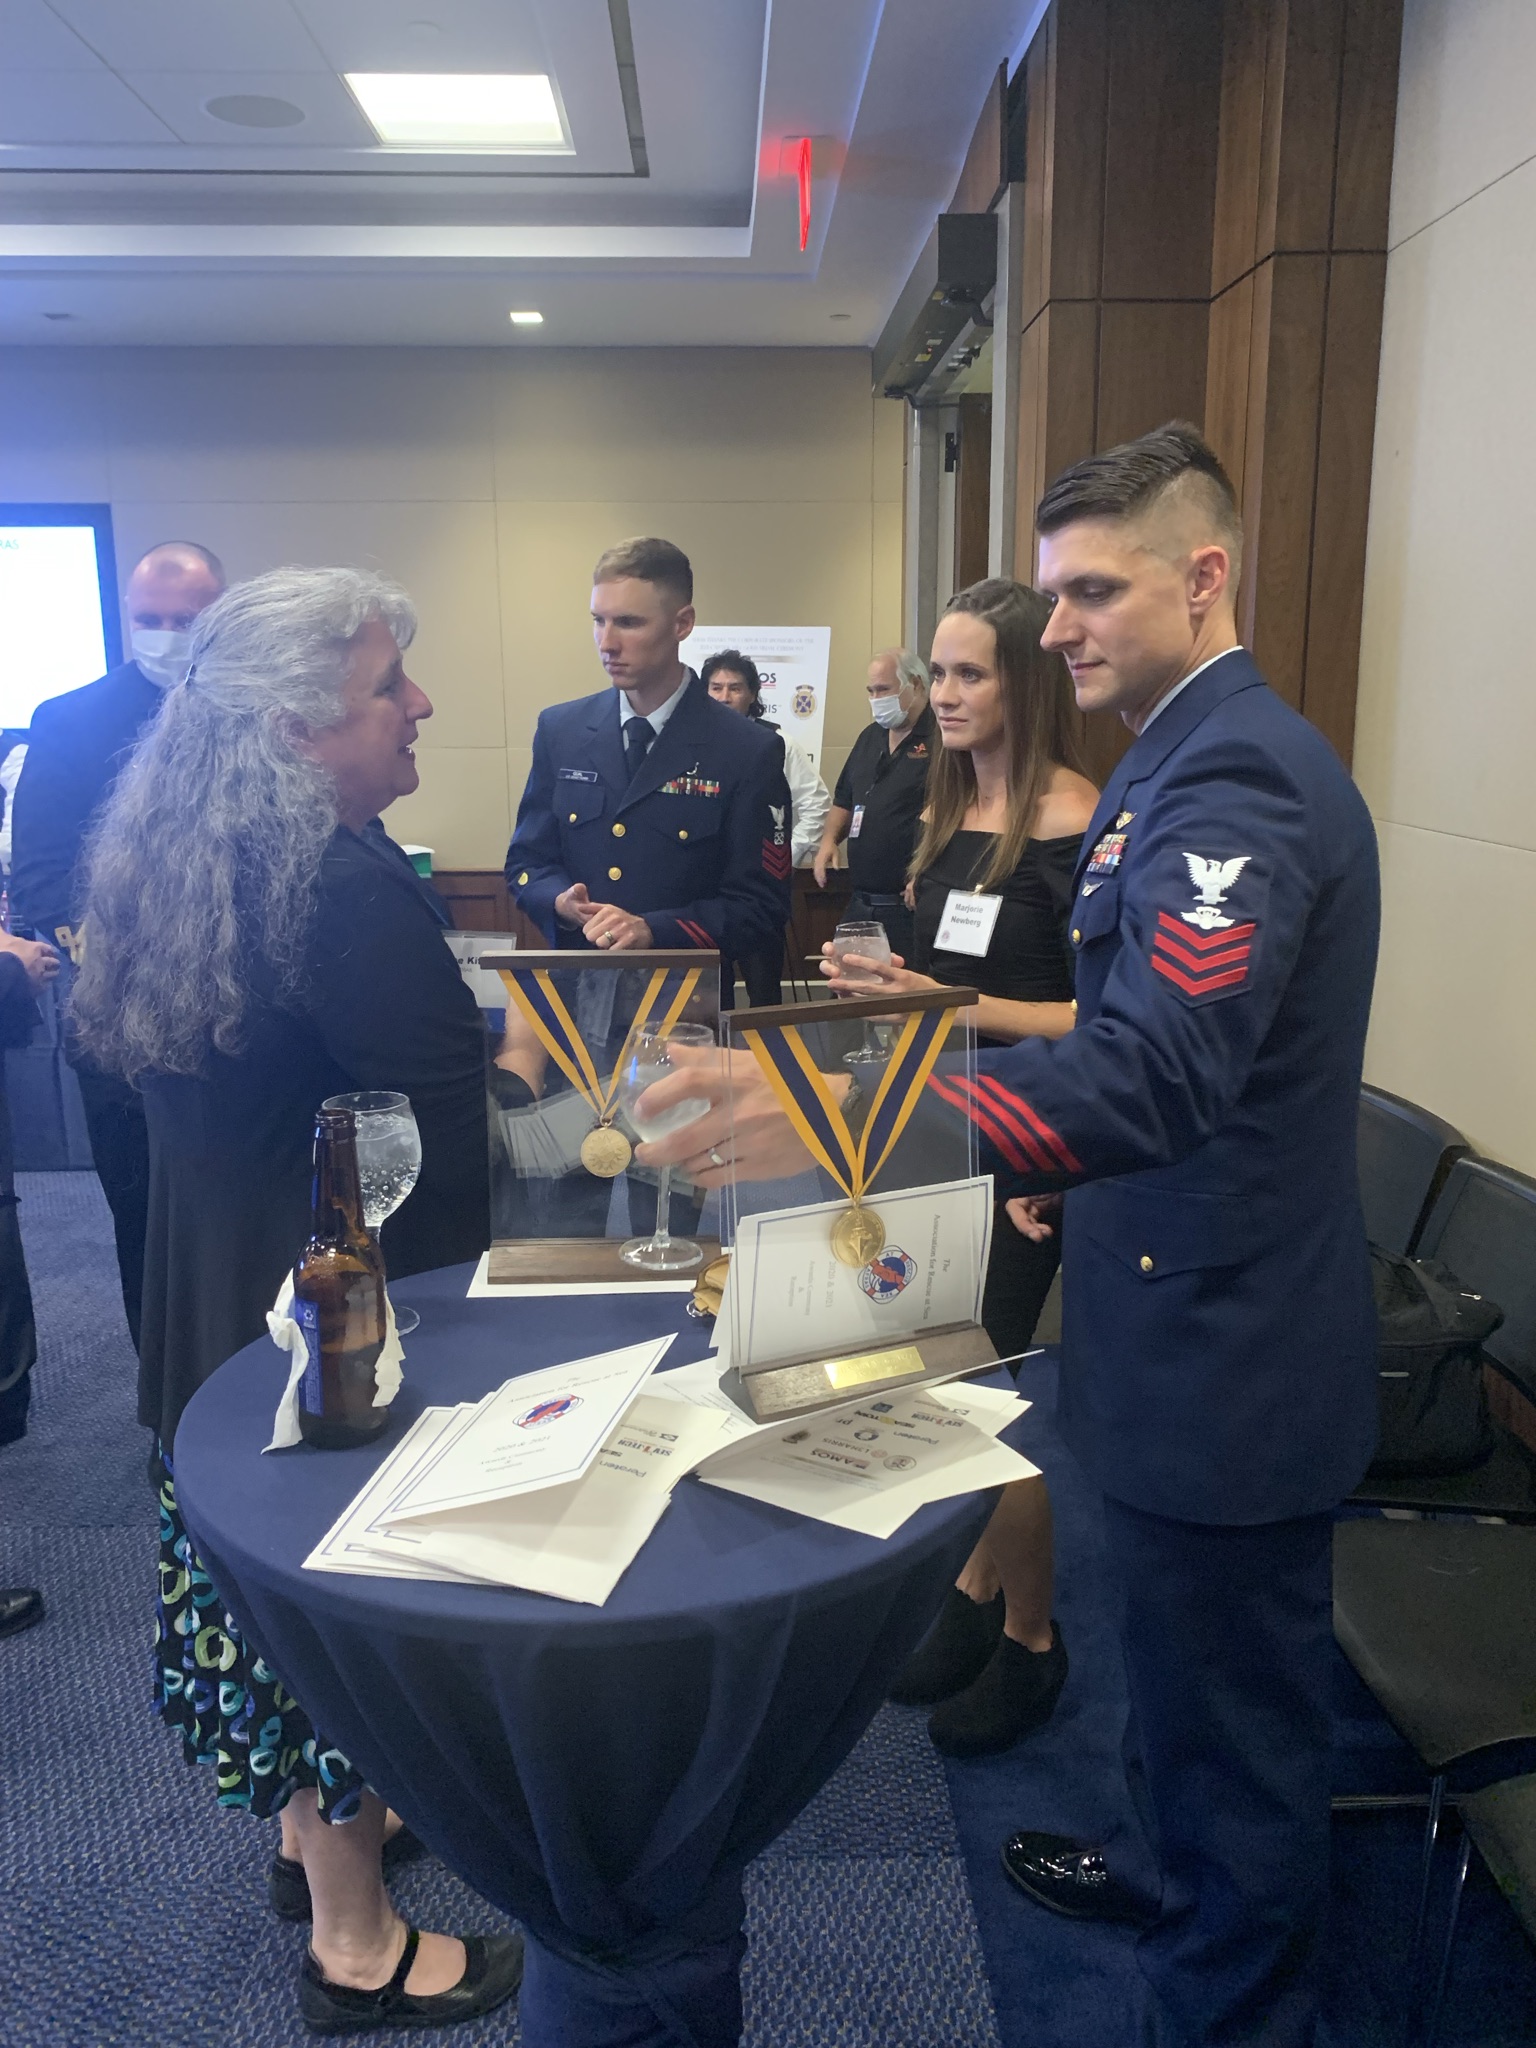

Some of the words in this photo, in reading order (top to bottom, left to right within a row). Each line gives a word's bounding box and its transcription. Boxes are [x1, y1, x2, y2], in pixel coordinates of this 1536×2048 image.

[954, 903, 984, 914] Marjorie
[950, 915, 982, 928] Newberg
[942, 1258, 951, 1273] The
